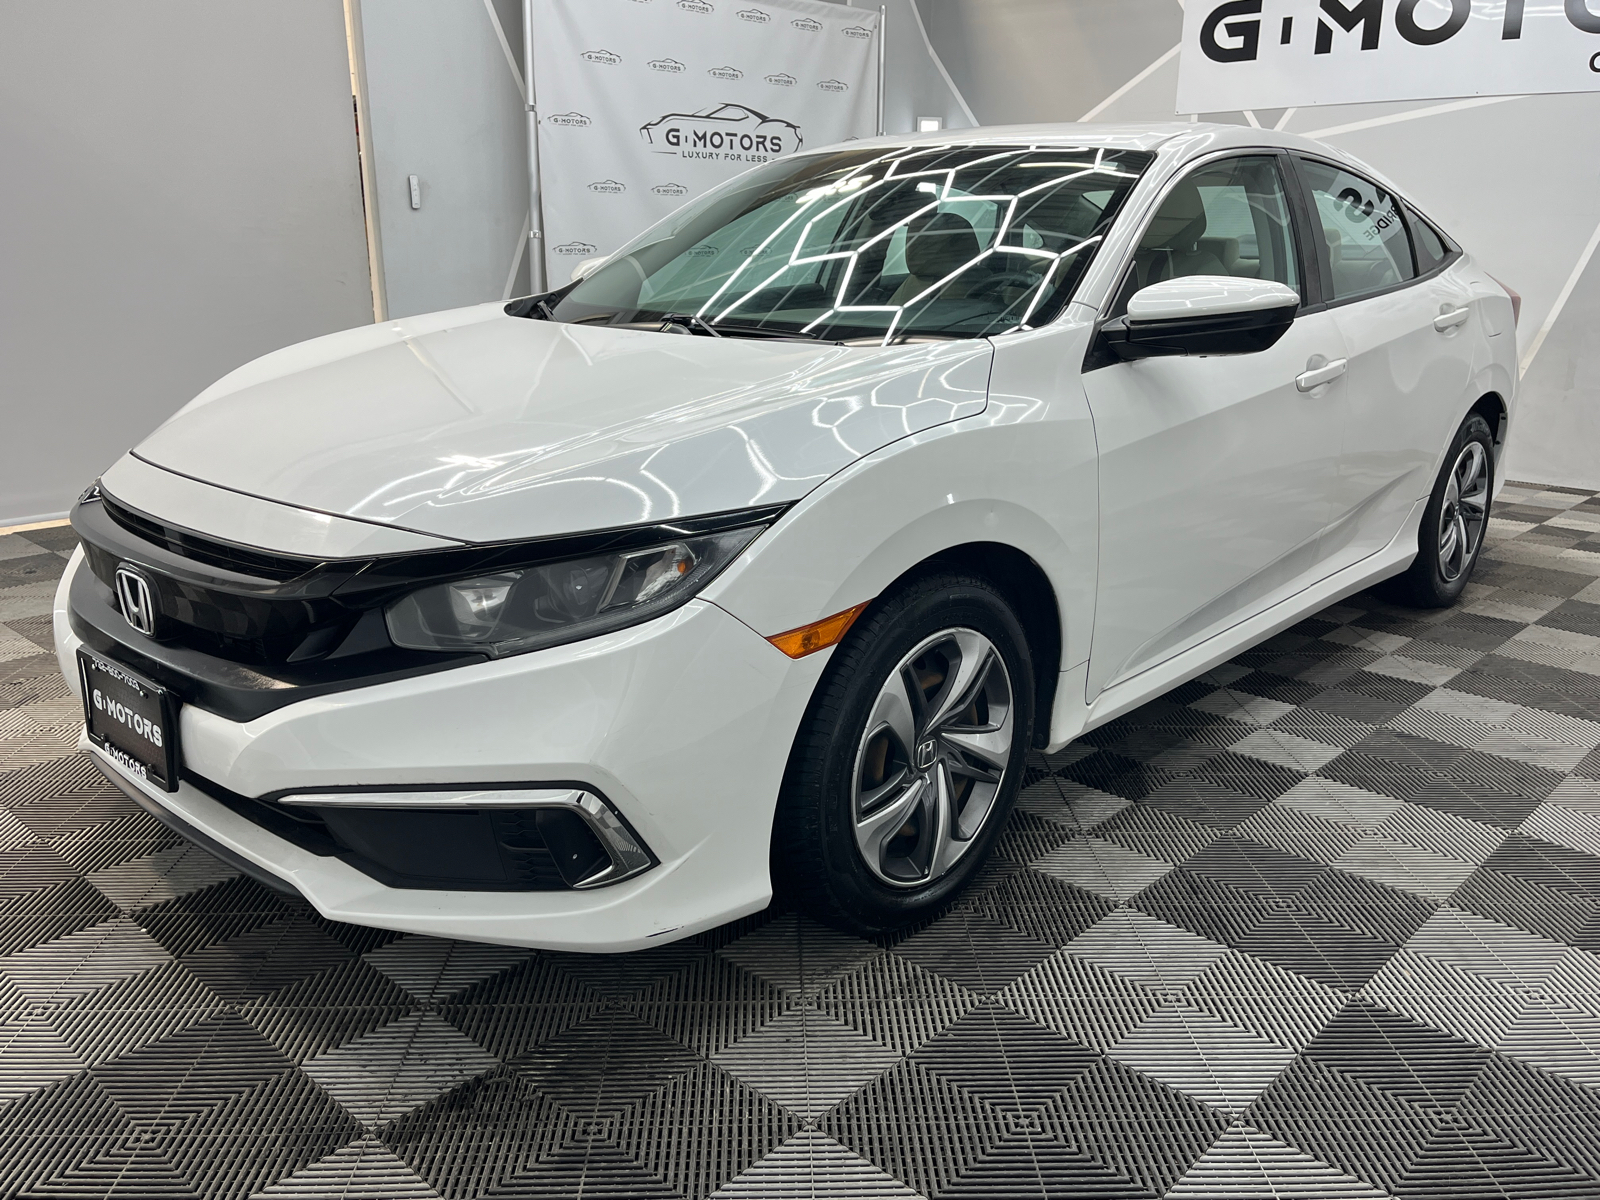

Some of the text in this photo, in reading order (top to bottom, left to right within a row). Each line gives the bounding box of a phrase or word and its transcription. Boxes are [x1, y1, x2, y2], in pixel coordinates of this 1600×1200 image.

[682, 150, 768, 163] LUXURY FOR LESS
